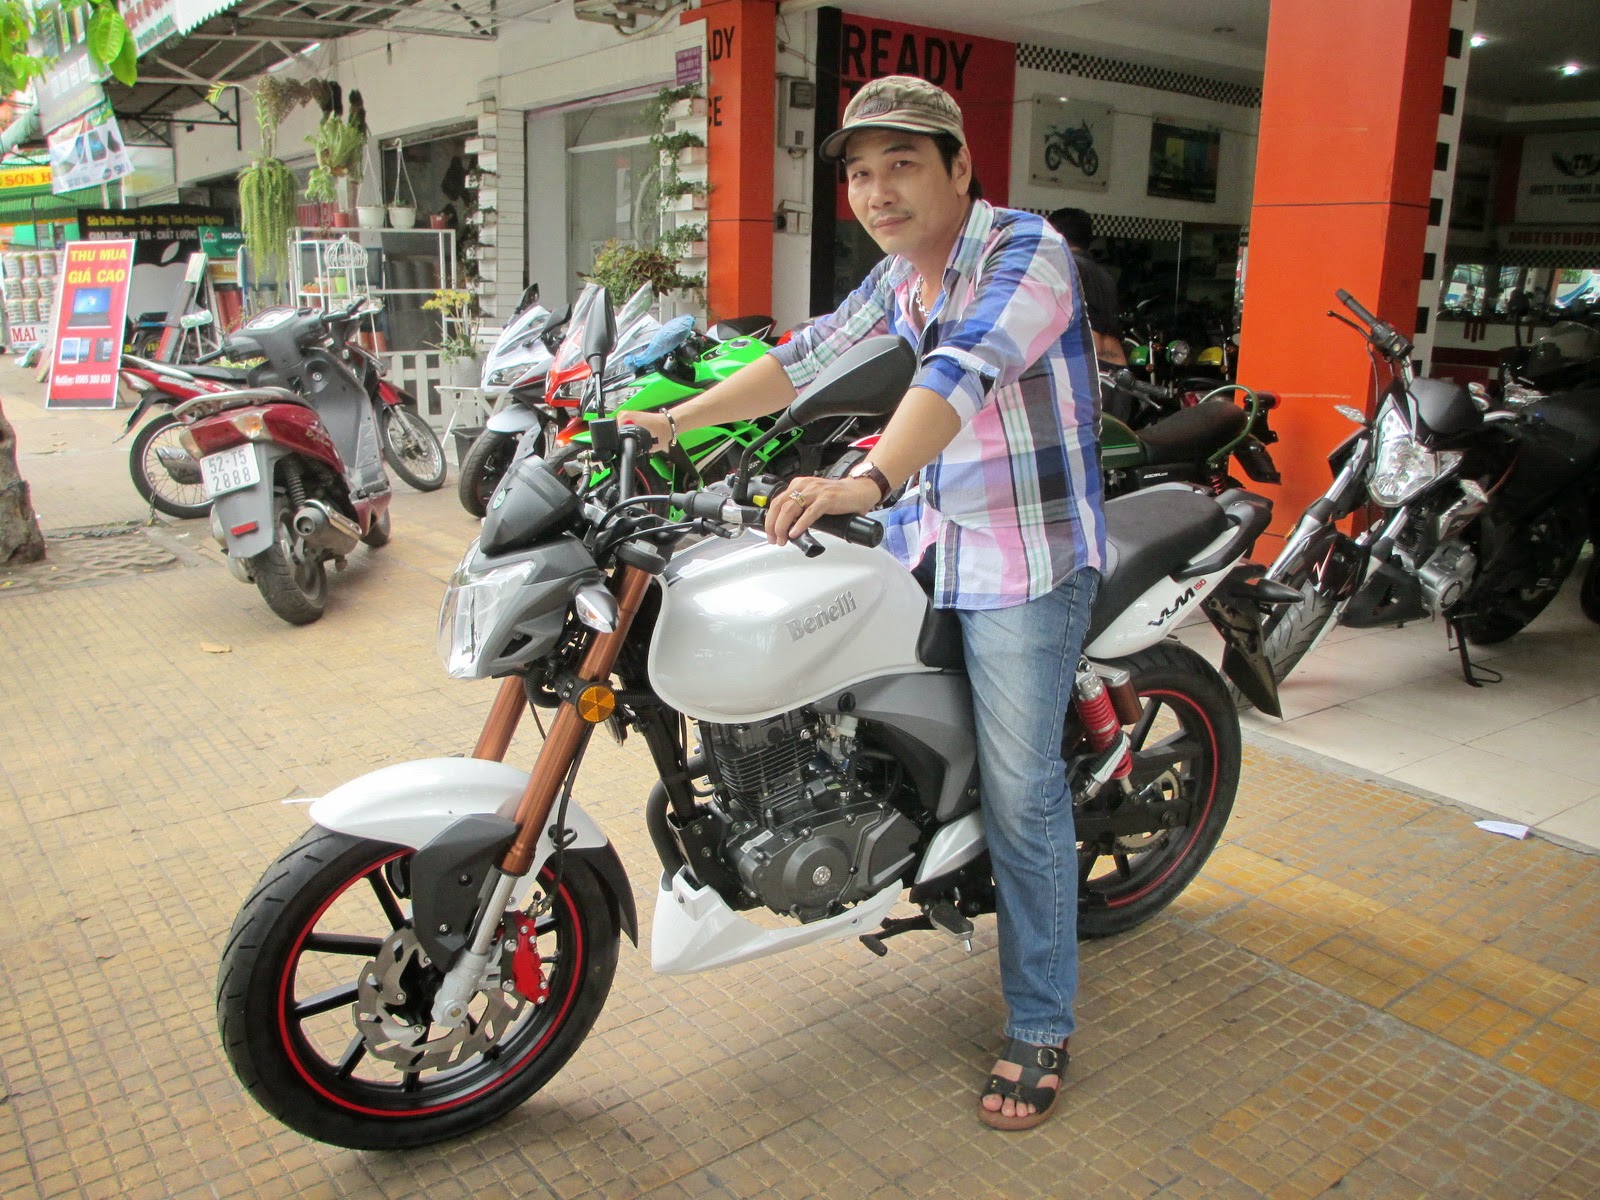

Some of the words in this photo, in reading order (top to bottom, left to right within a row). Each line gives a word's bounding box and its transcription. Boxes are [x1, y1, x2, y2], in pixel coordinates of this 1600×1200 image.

[842, 23, 973, 91] READY
[70, 249, 96, 262] THU
[99, 248, 127, 261] MUA
[67, 267, 92, 284] GIÁ
[96, 269, 126, 283] CAO
[11, 326, 37, 342] MAI
[212, 467, 251, 492] 2888
[785, 590, 857, 643] Benelli
